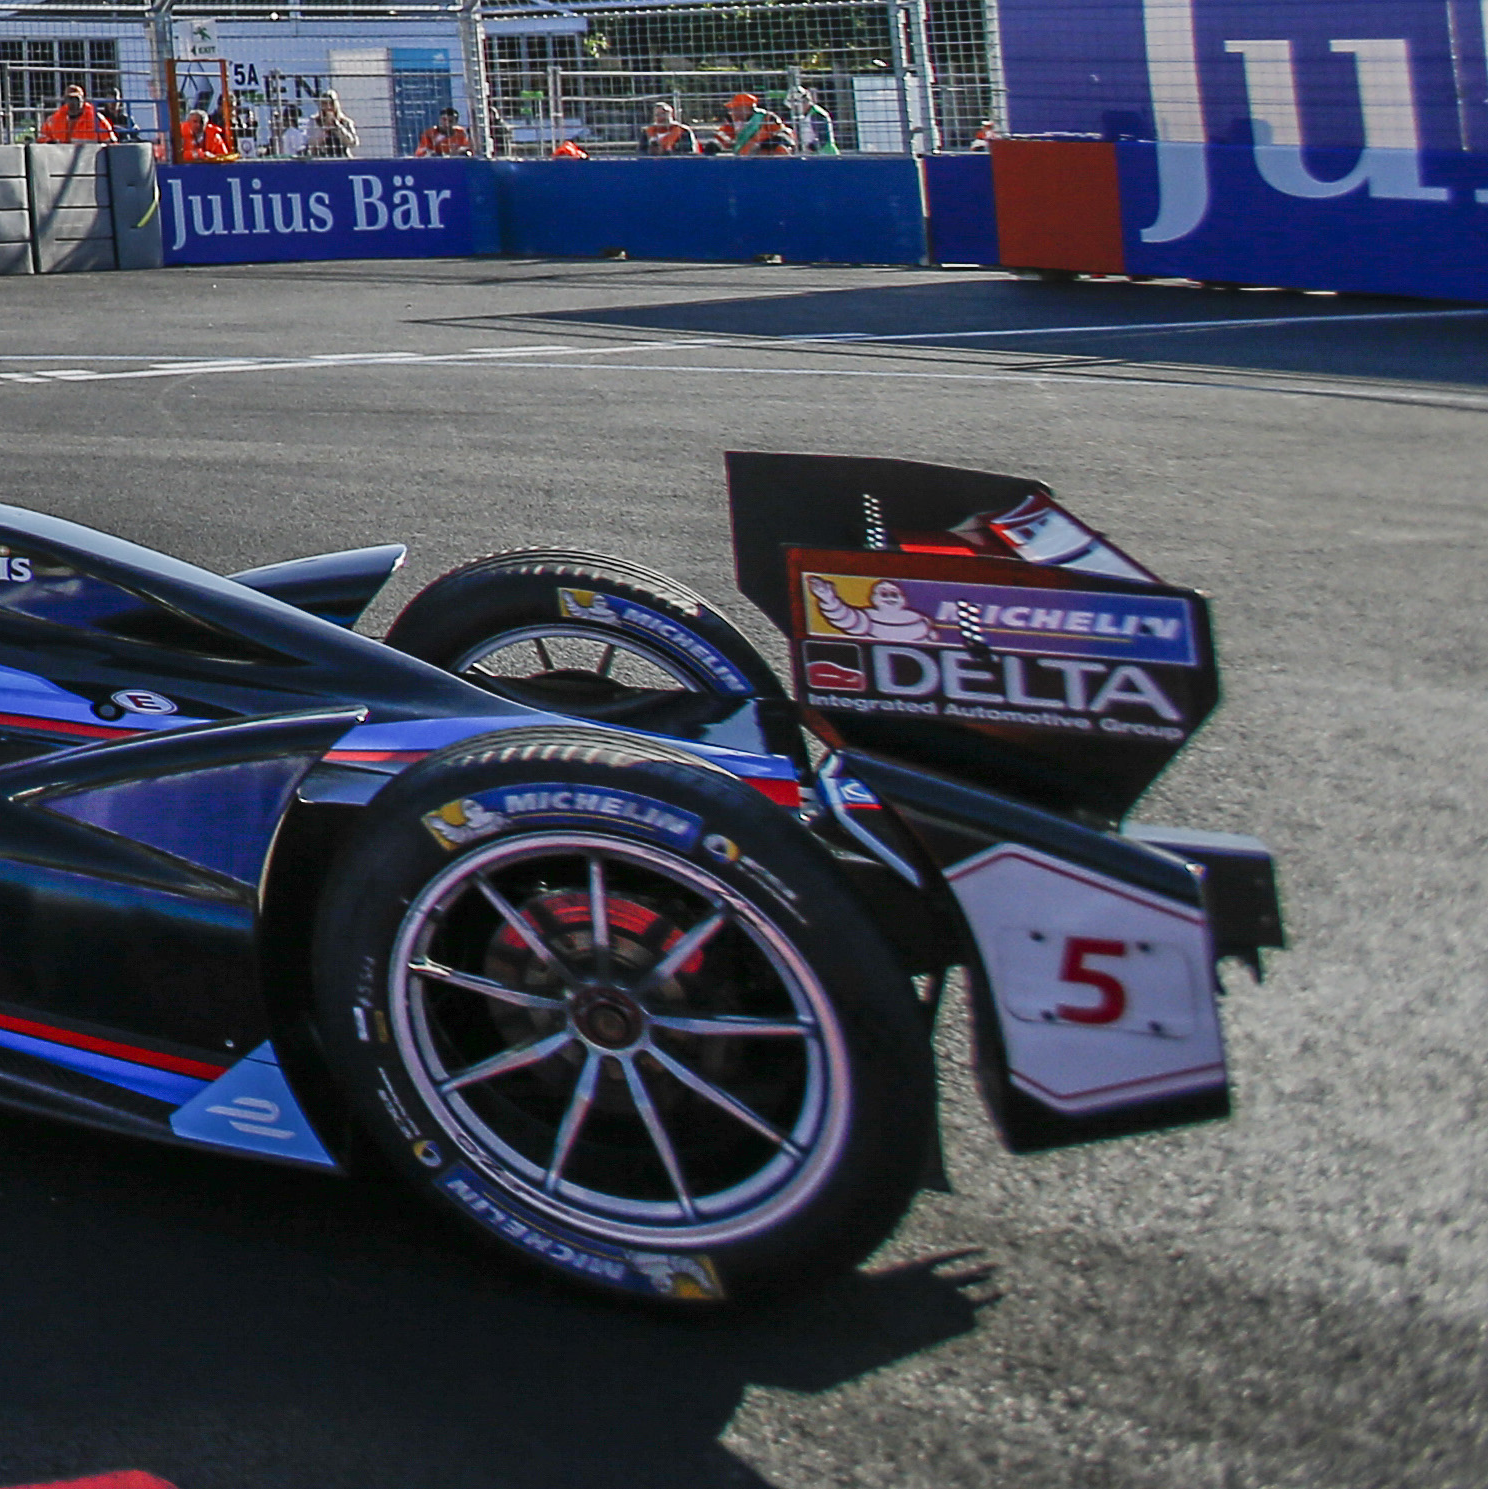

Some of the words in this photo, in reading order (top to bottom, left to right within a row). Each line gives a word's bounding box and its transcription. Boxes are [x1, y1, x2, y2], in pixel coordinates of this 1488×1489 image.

[197, 45, 217, 54] EXIT
[233, 62, 260, 86] 5A
[167, 177, 334, 251] Julius
[348, 174, 452, 231] Bär
[623, 608, 748, 692] MICHELIN
[871, 644, 1183, 721] DELTA
[808, 692, 937, 715] Integrated
[944, 702, 1092, 731] Automotive
[1099, 717, 1185, 741] Group
[503, 792, 690, 835] MICHELIN
[1056, 936, 1130, 1025] 5
[446, 1178, 625, 1281] MICHELIN
